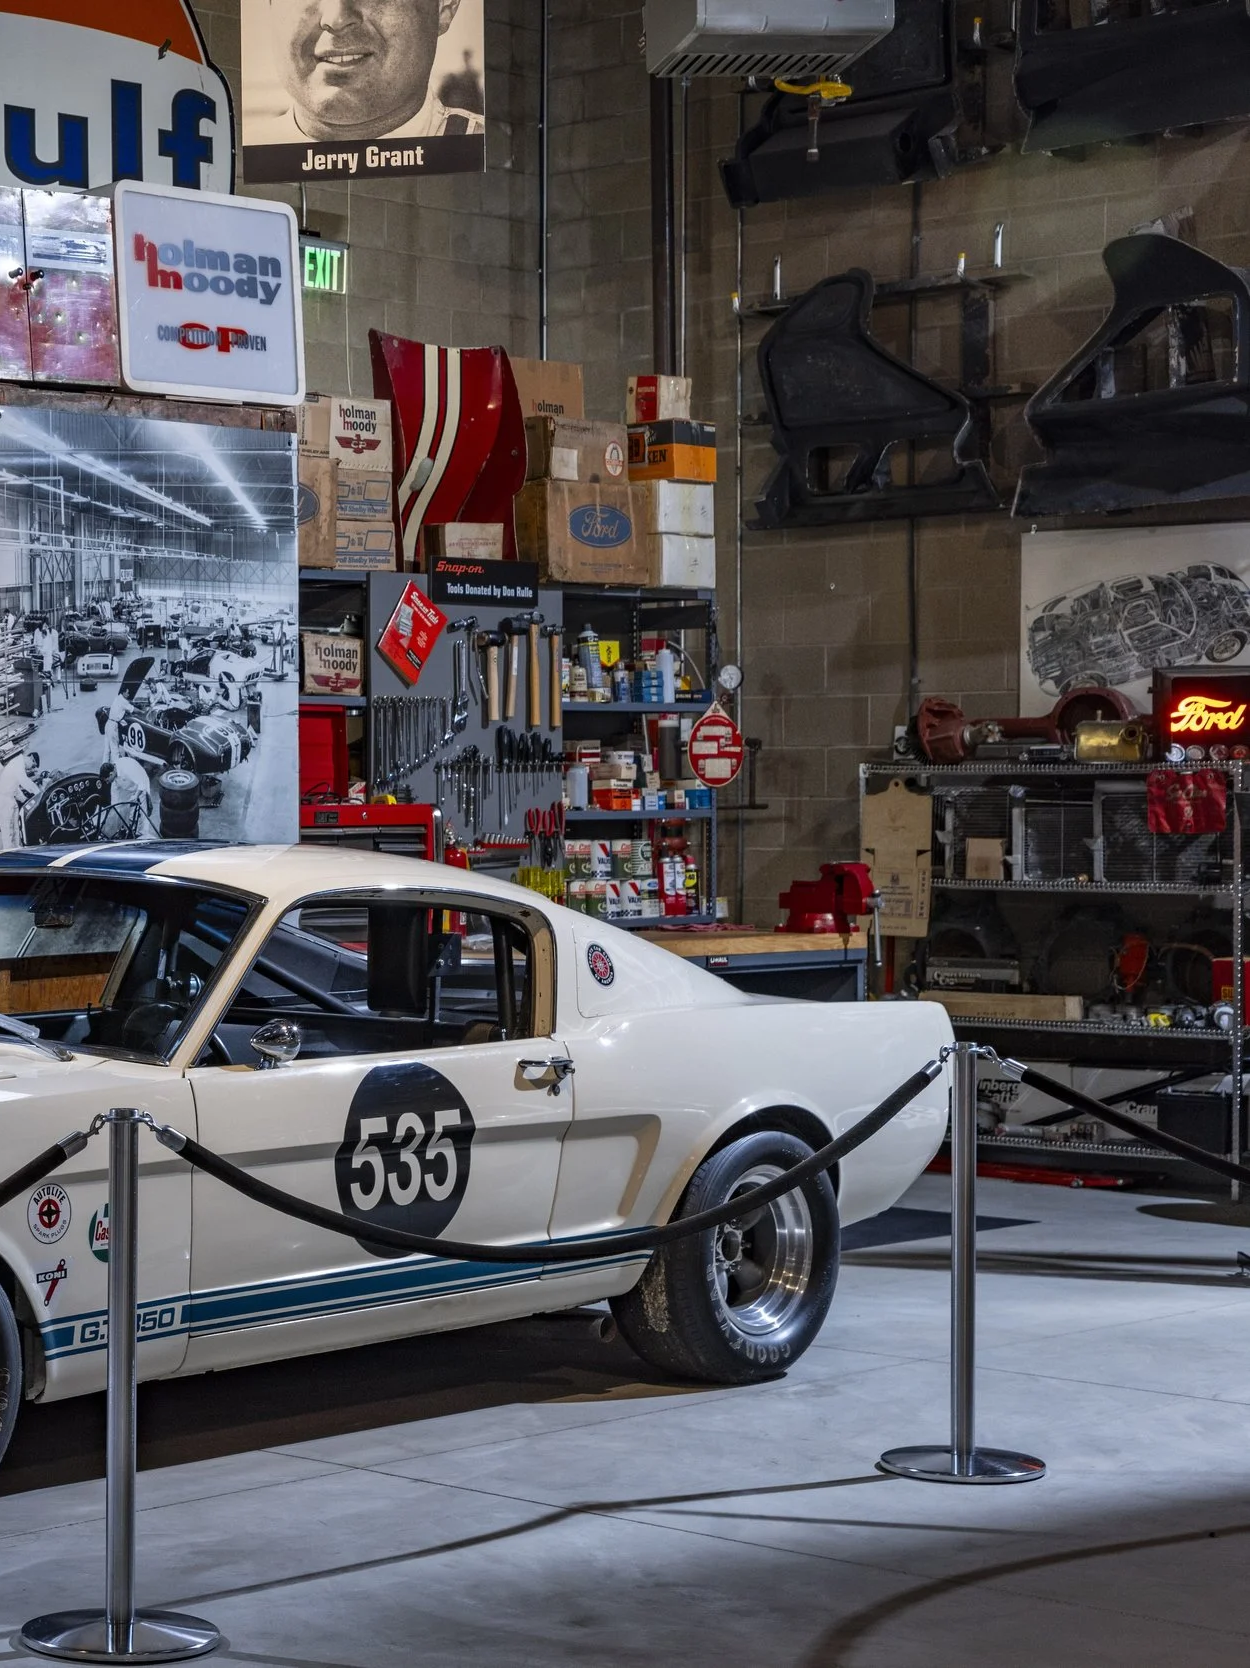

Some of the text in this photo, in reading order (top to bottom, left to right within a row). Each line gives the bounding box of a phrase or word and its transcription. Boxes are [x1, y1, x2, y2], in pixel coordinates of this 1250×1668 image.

[301, 145, 424, 173] Jerry Grant
[133, 233, 282, 278] holman
[304, 246, 341, 291] EXIT
[147, 267, 282, 305] moody
[157, 324, 267, 352] COMPETITION PROVEN
[339, 404, 376, 420] holman
[342, 419, 377, 435] moody
[581, 511, 620, 539] Ford
[436, 560, 484, 576] Snap-on
[447, 582, 532, 598] Tools Donated by Don Rulle
[314, 642, 358, 660] holman
[319, 658, 358, 673] moody
[1170, 695, 1248, 733] Ford
[130, 726, 144, 749] 98
[350, 1108, 462, 1211] 535
[32, 1186, 66, 1206] AUTOLITE
[32, 1219, 68, 1239] SPARK PLUGS
[38, 1270, 66, 1280] KONI
